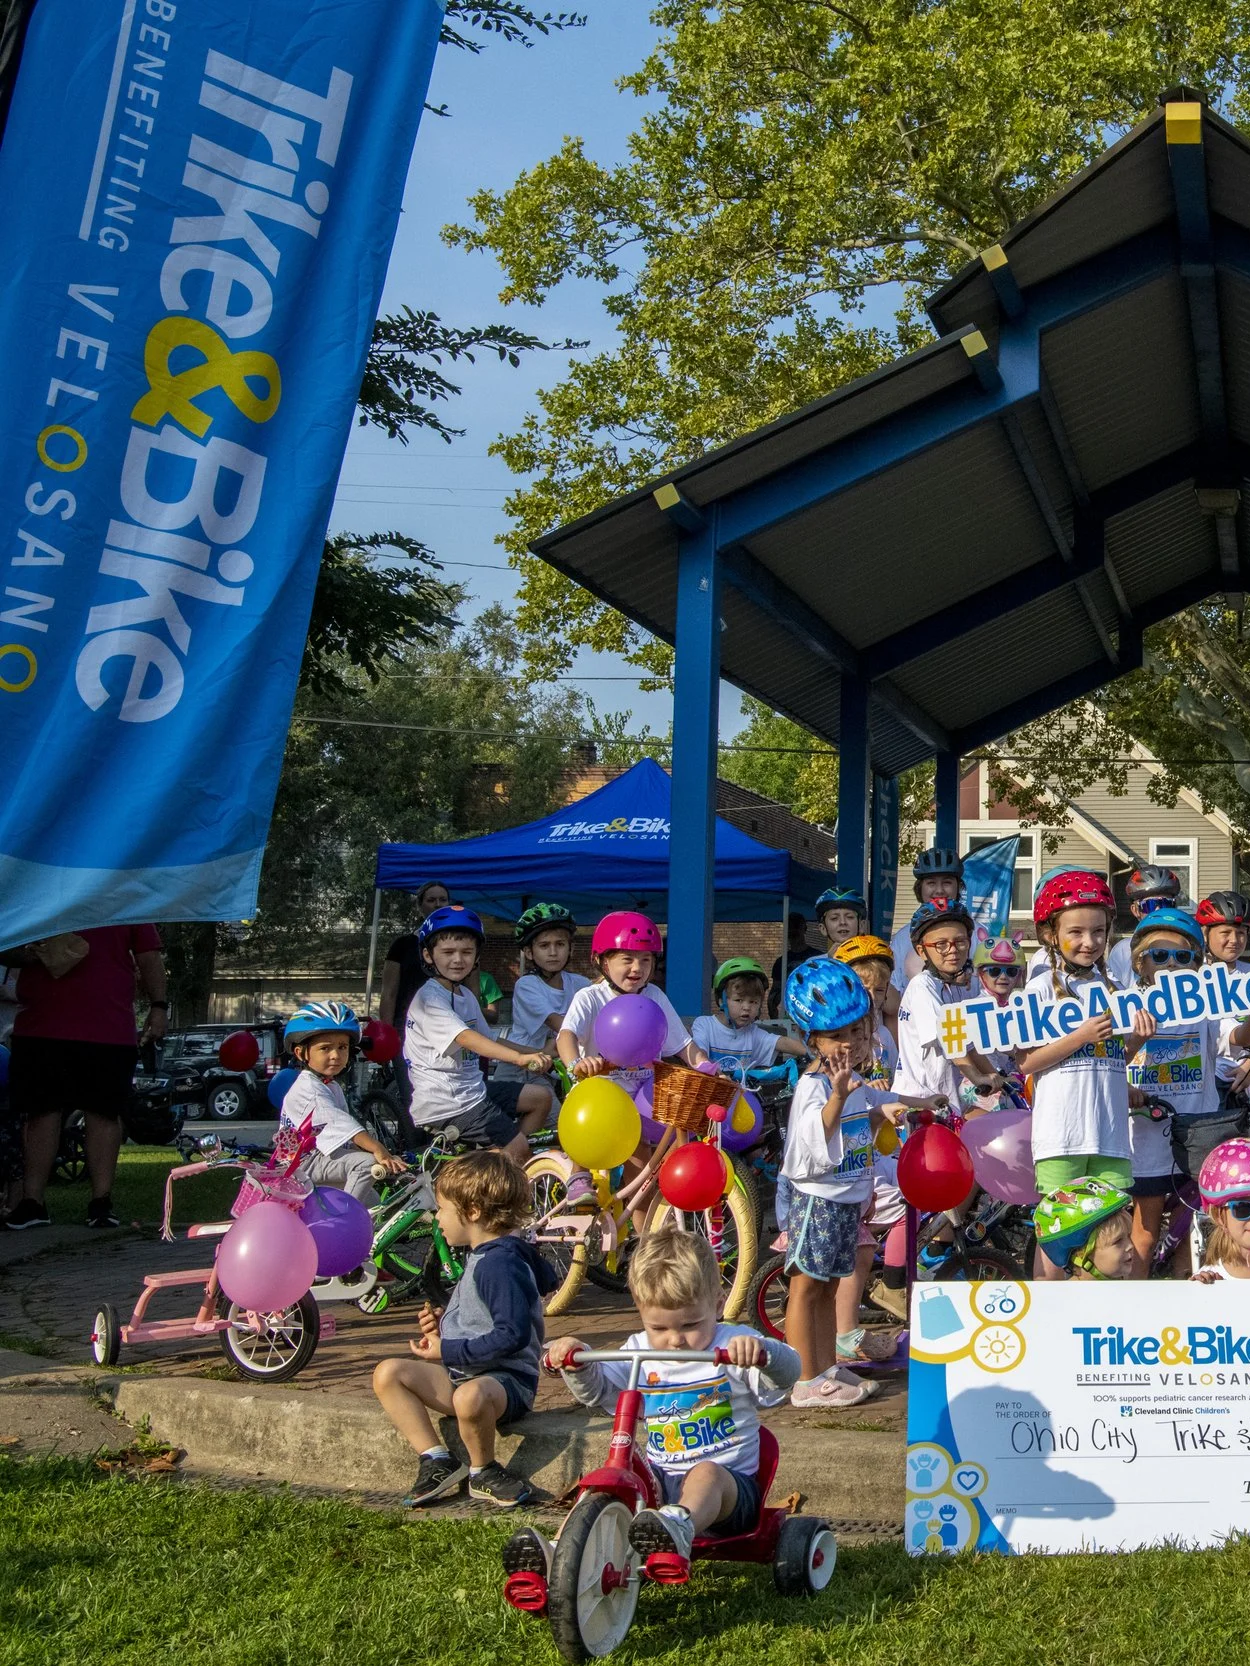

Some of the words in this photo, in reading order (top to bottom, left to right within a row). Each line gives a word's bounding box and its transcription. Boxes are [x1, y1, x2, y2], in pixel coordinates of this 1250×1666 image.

[97, 0, 177, 254] BENEFITING
[75, 48, 354, 724] Trike&Bike
[0, 283, 120, 693] VELOSANO
[550, 817, 671, 838] Trike&Bik
[1128, 1063, 1203, 1084] Trike&Bike
[1076, 1373, 1151, 1382] BENEFITING
[1119, 1395, 1151, 1403] supports
[1153, 1394, 1186, 1403] pediatric
[1172, 1407, 1194, 1415] Clinic
[1011, 1420, 1080, 1454] Ohio
[1091, 1418, 1138, 1464] City
